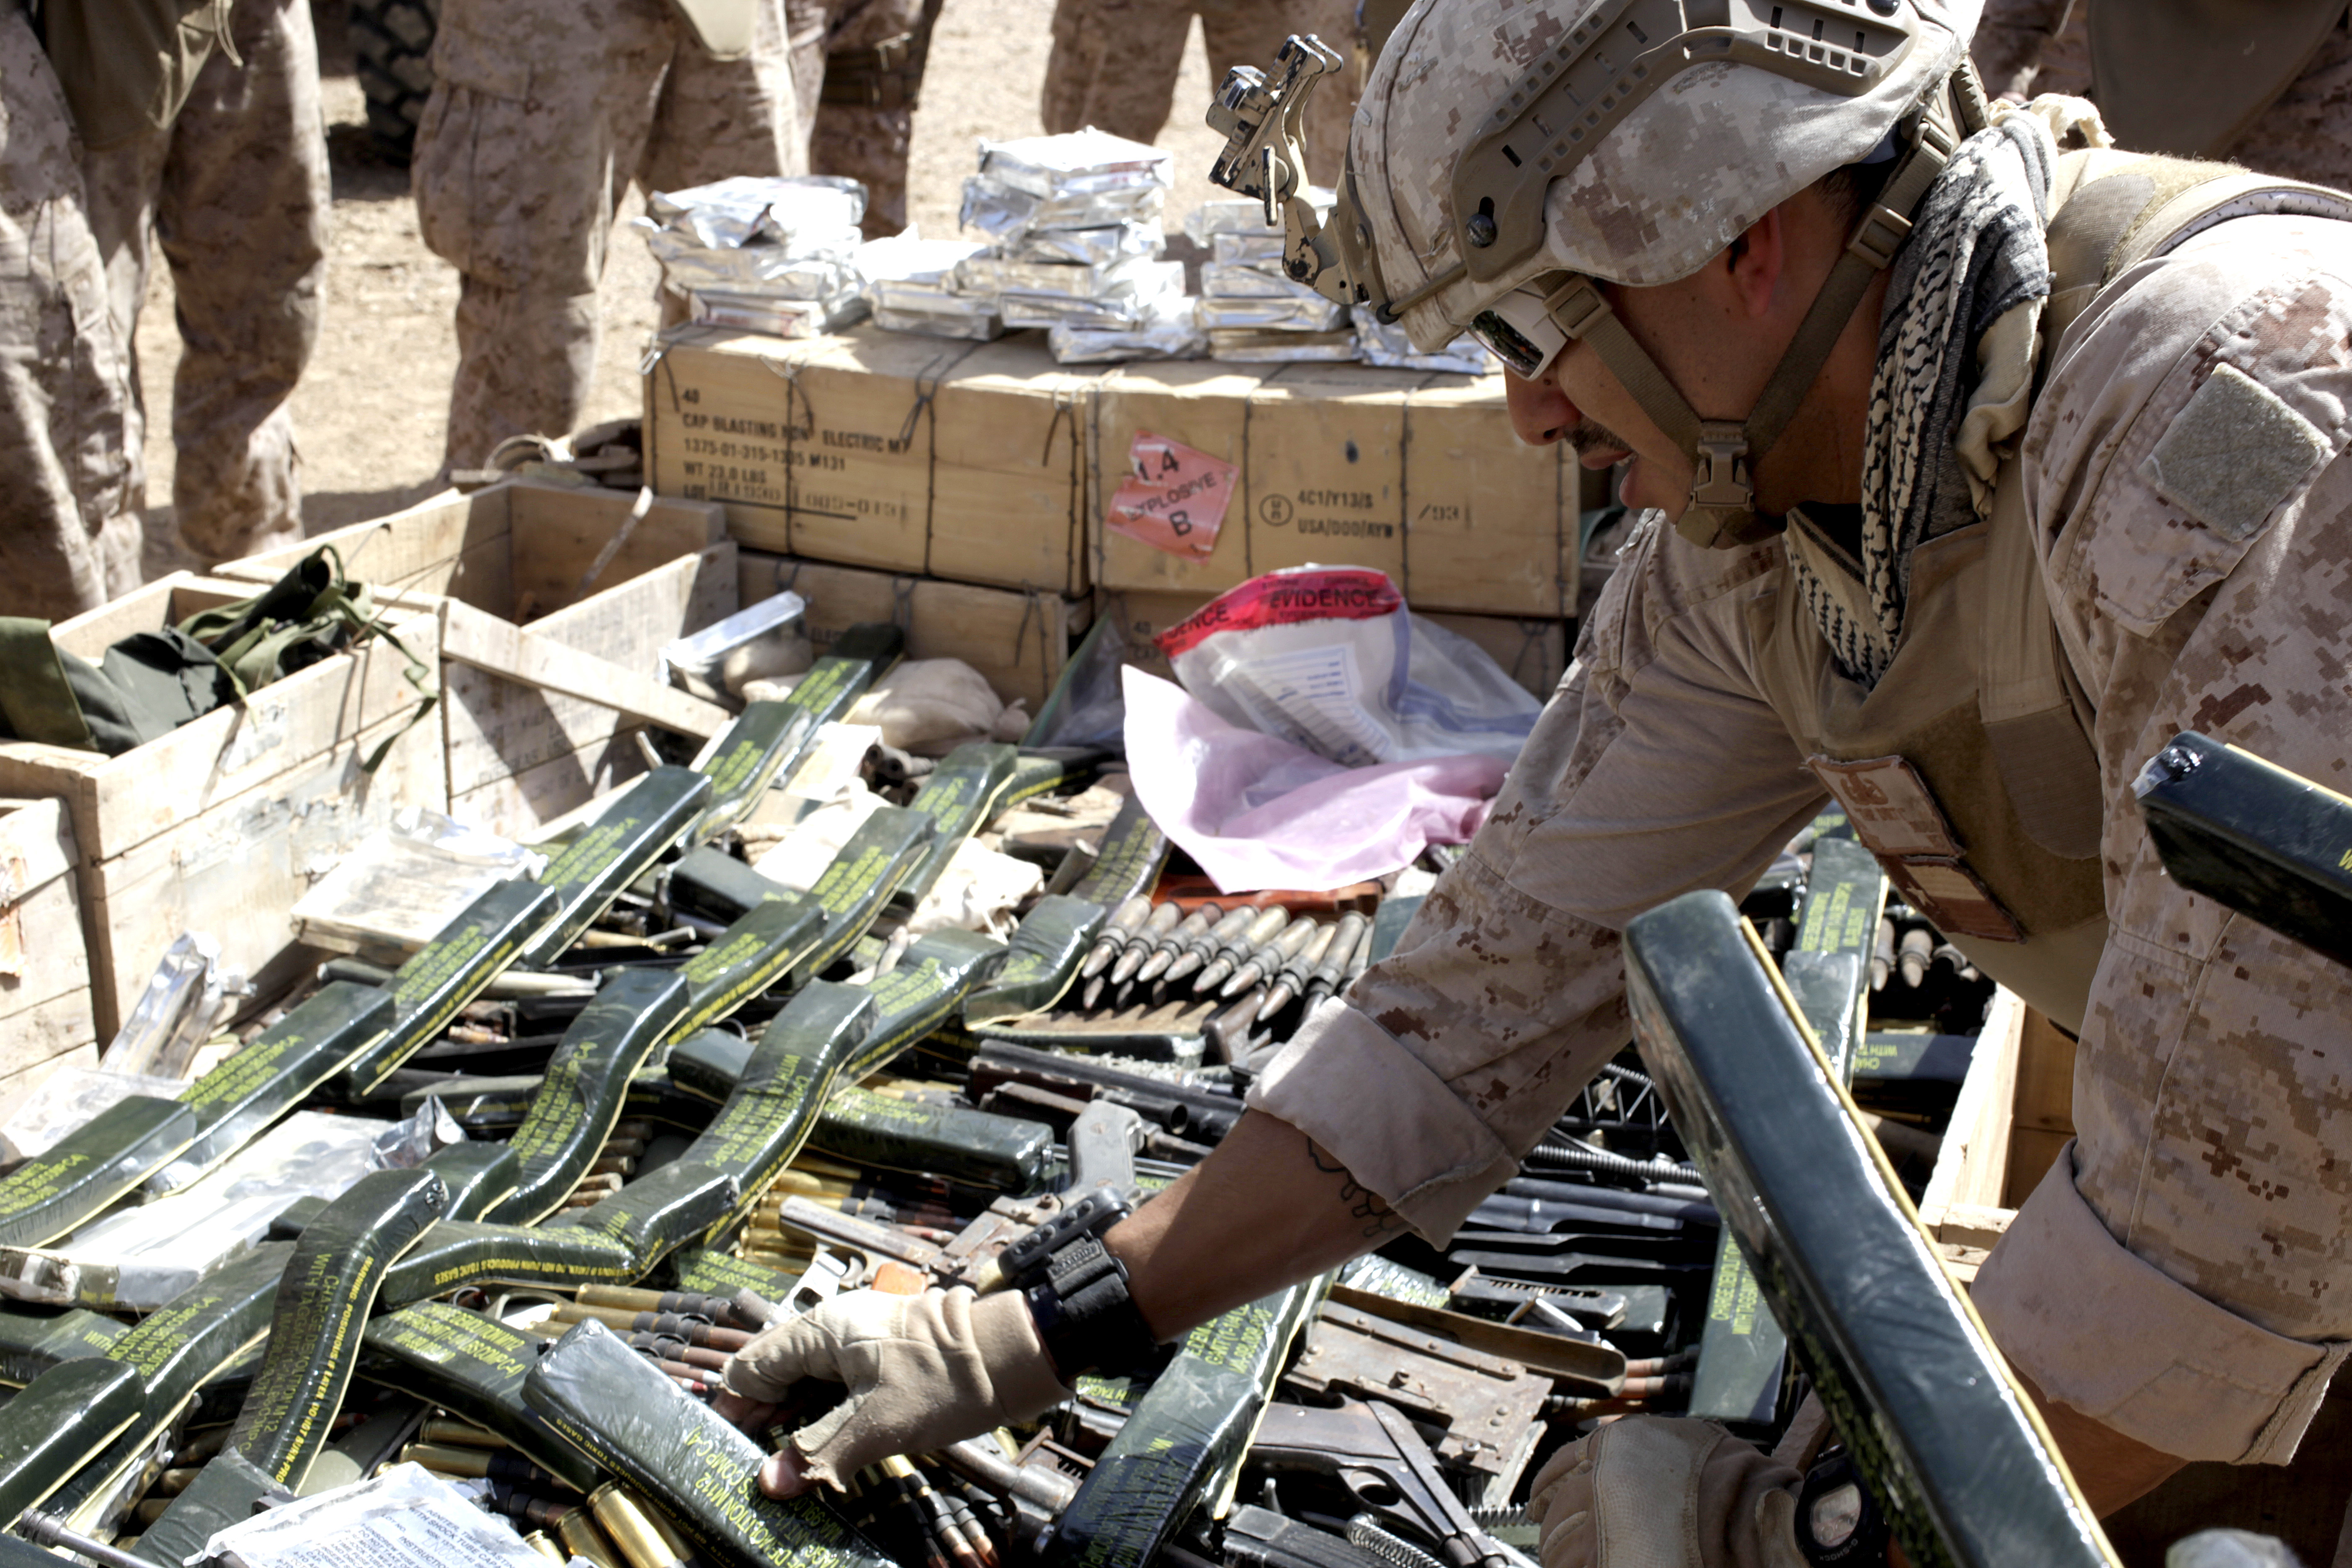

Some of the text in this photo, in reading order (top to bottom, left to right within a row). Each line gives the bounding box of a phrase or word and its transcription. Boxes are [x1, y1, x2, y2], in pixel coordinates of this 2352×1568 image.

[714, 416, 776, 438] BLASTING
[1169, 511, 1192, 537] B
[1270, 588, 1380, 609] EVIDENCE
[304, 1250, 332, 1287] WITH
[346, 1254, 375, 1303] WARNING:
[434, 1267, 459, 1285] GASES
[307, 1274, 340, 1333] CHARGE
[328, 1303, 353, 1360] POISONOUS
[280, 1333, 318, 1404] DEMOLITION
[325, 1359, 336, 1370] IF
[307, 1401, 320, 1417] DO
[297, 1416, 314, 1437] NOT
[555, 1417, 584, 1442] GASES
[583, 1439, 610, 1462] TOXIC
[683, 1426, 715, 1458] C-4)
[703, 1446, 747, 1488] COMP
[694, 1470, 793, 1567] DEMOLITION M112
[358, 1528, 401, 1564] DO NOT TAKE
[428, 1518, 456, 1540] SHOCK
[456, 1537, 479, 1555] TUBE
[461, 1530, 482, 1548] TIME
[397, 1551, 415, 1566] FUSE
